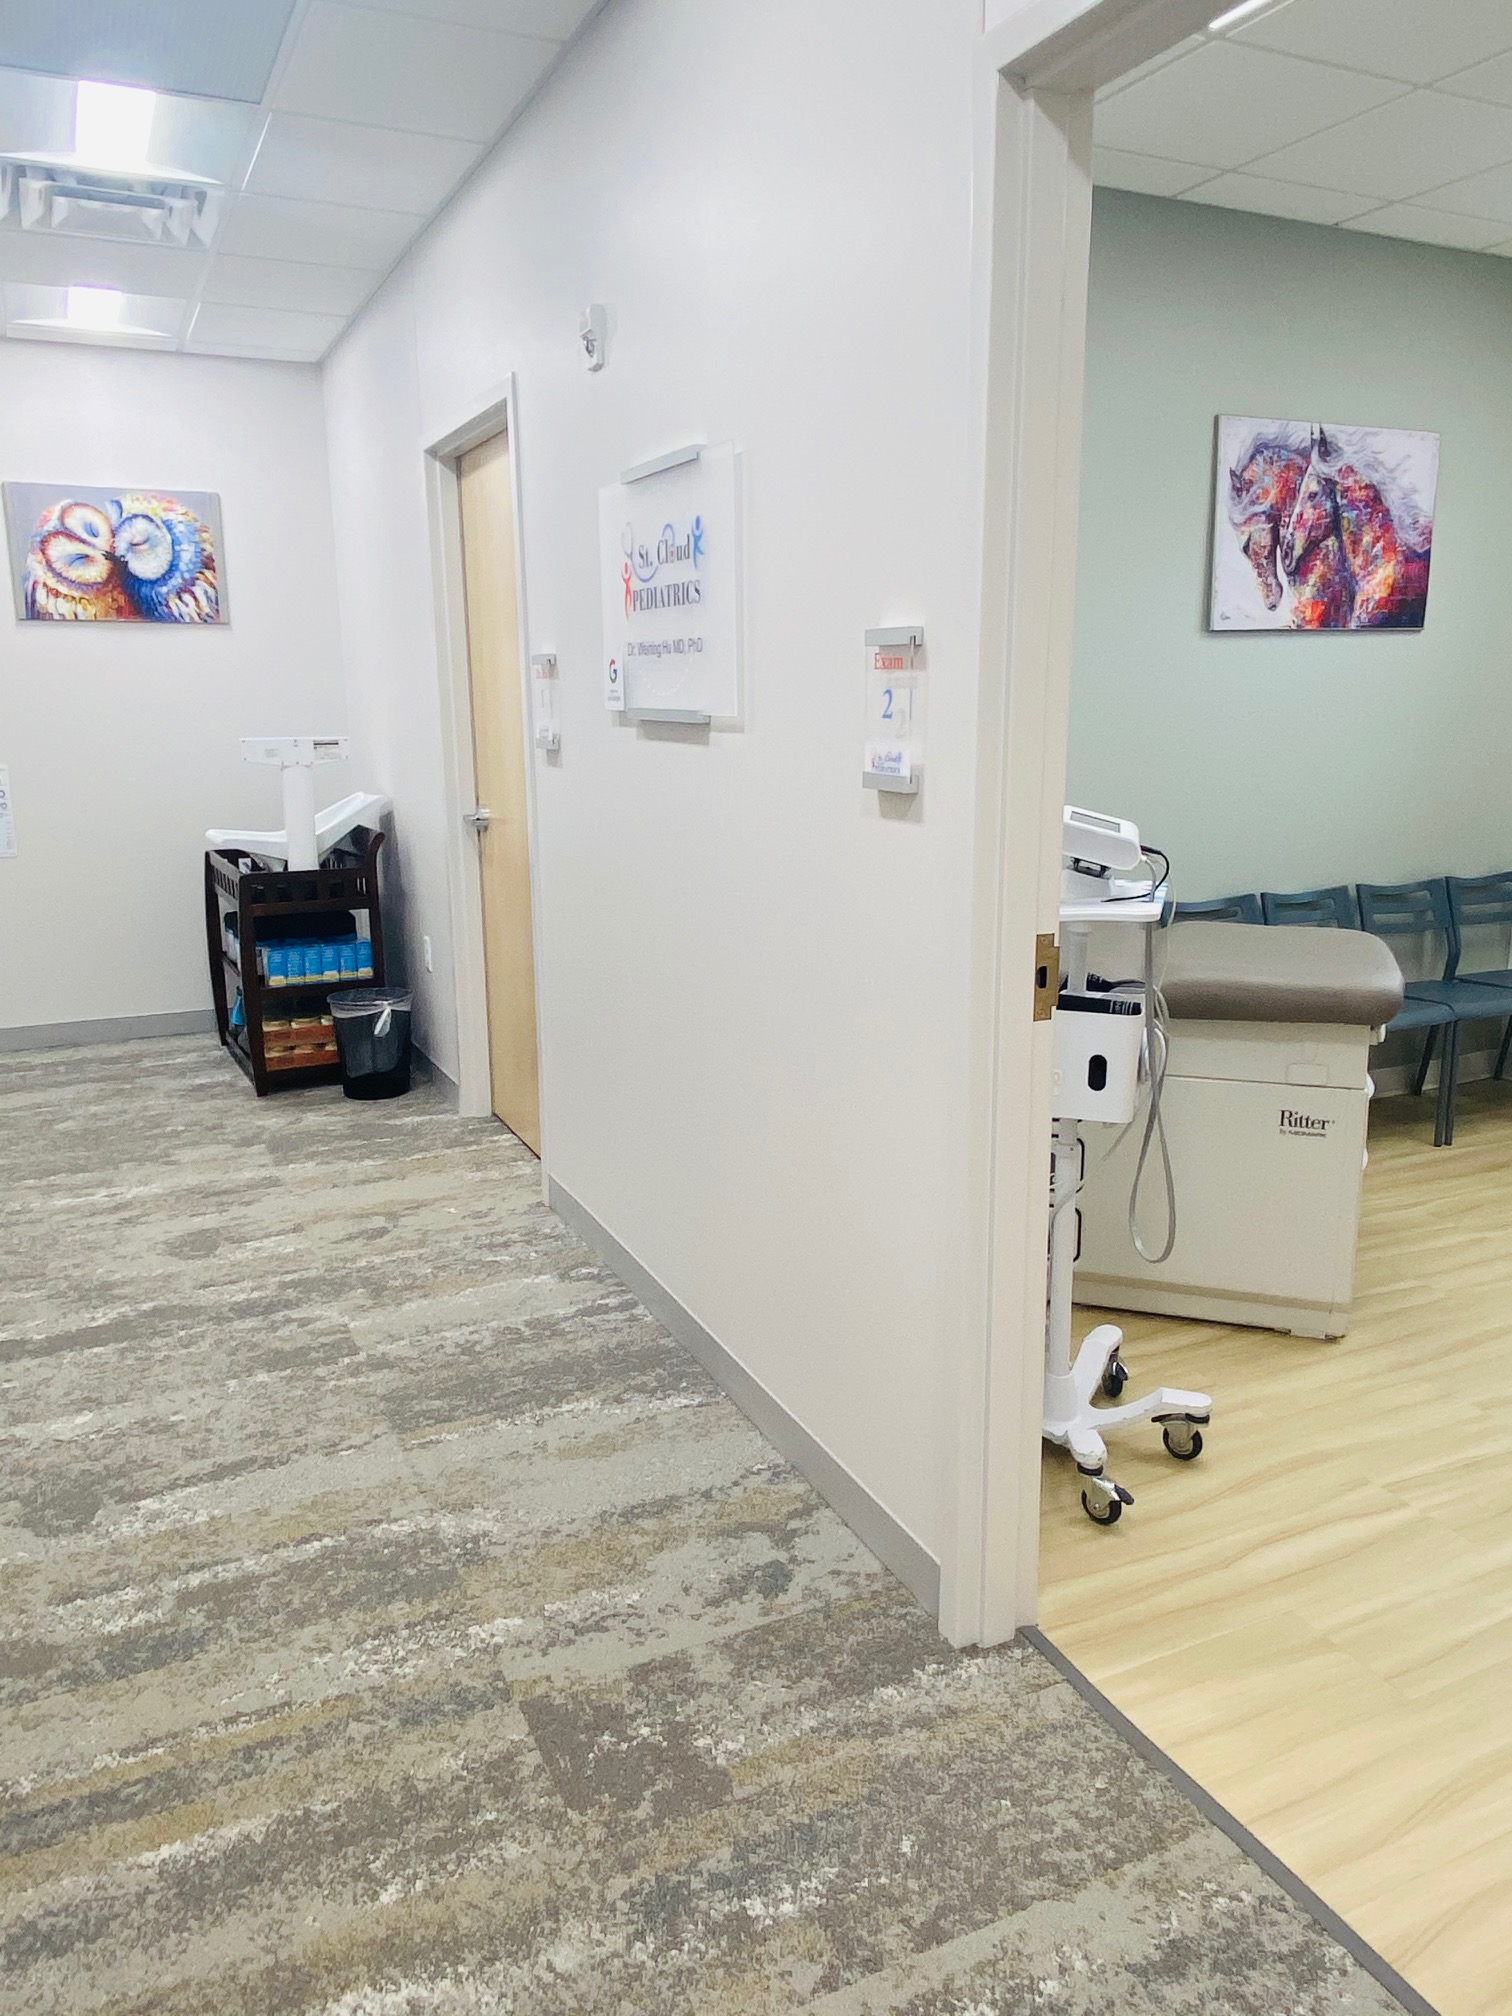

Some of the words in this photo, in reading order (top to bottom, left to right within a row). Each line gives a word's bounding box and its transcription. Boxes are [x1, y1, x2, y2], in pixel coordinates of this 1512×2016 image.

[638, 545, 653, 569] St.
[657, 533, 690, 565] Cloud
[633, 580, 701, 612] PEDIATRICS
[875, 653, 903, 669] Exam
[882, 689, 893, 719] 2
[1279, 1109, 1330, 1129] Ritter
